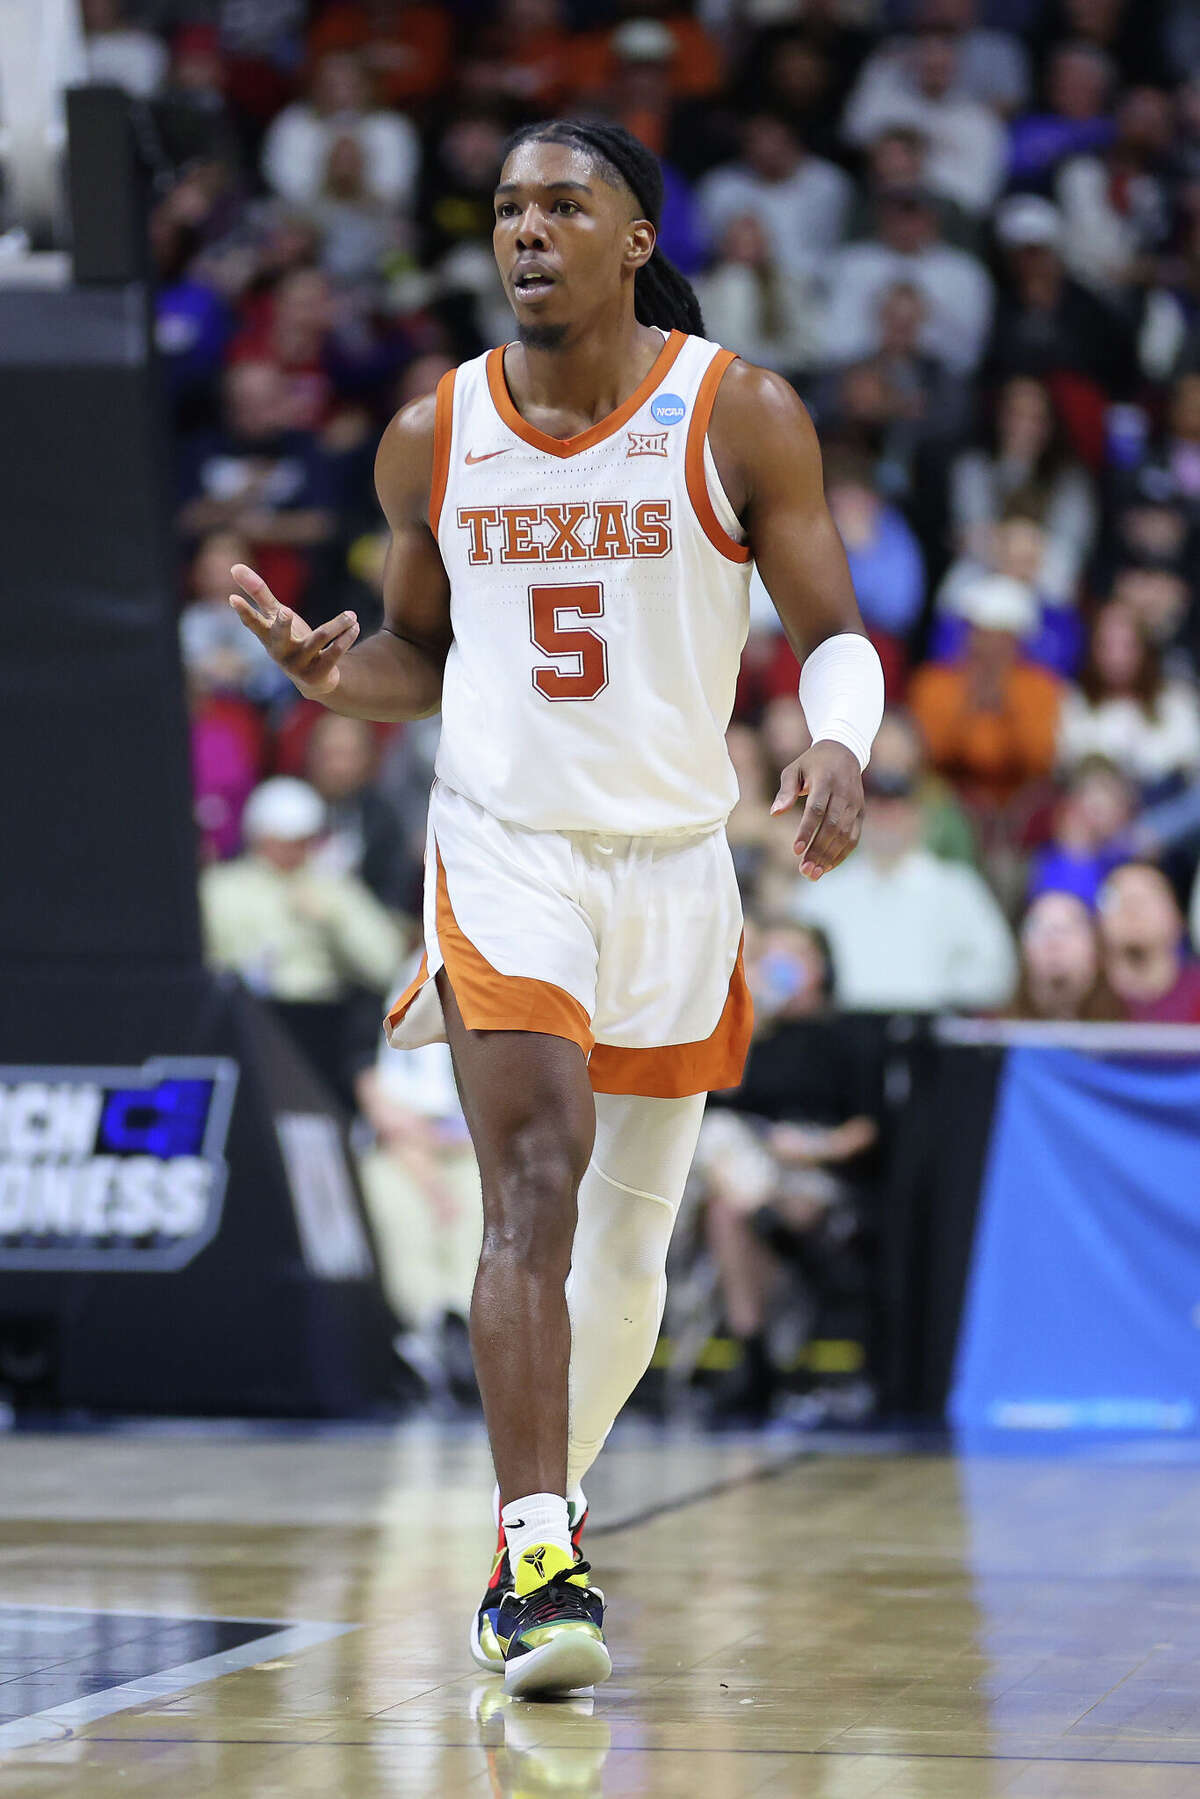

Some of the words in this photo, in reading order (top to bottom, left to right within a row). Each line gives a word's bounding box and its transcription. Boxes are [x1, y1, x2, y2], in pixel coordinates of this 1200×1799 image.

[656, 407, 684, 417] NCAA
[457, 500, 672, 565] TEXAS
[528, 582, 609, 701] 5
[0, 1082, 101, 1152] CH
